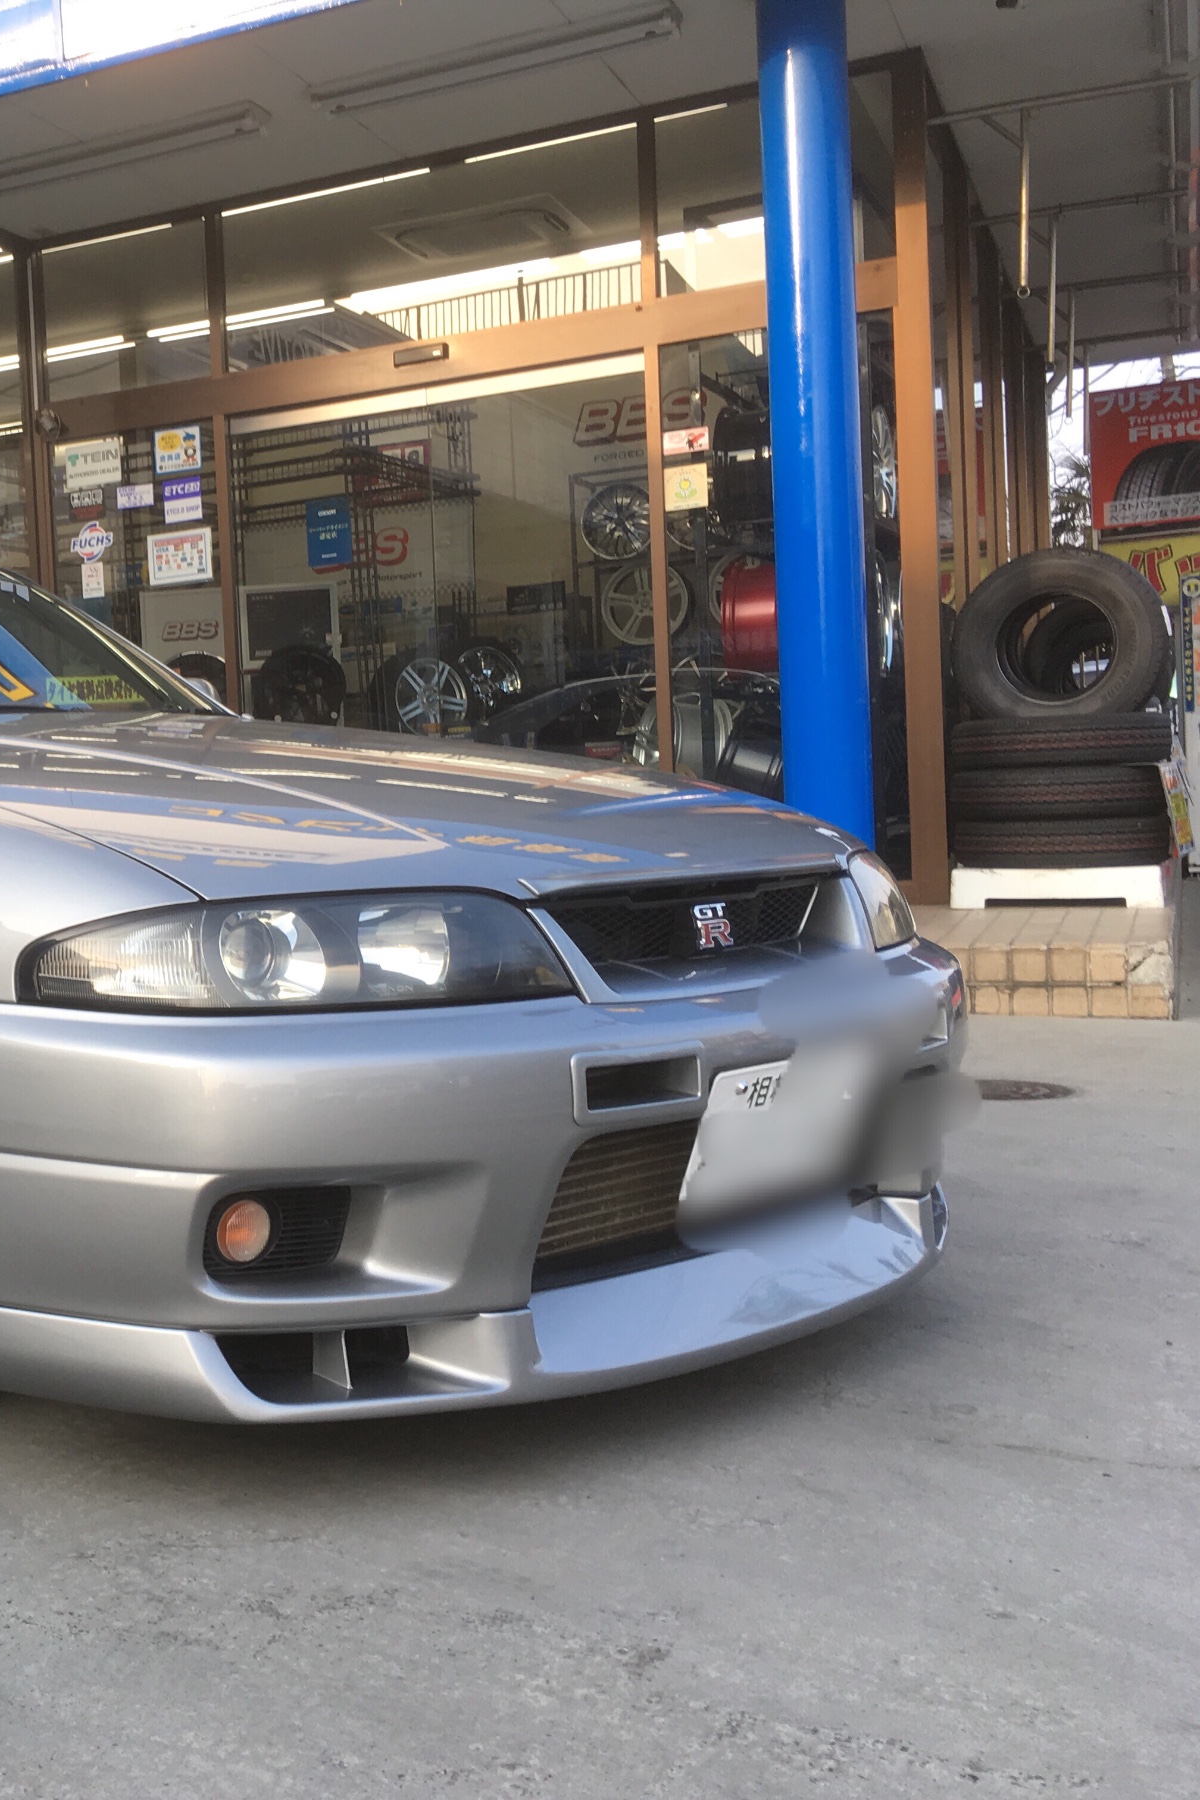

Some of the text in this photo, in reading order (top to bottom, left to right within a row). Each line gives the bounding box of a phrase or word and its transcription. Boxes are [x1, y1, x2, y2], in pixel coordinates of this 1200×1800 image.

[1128, 409, 1199, 427] Firestone
[81, 448, 119, 465] TEIN
[593, 449, 644, 463] FORGED
[72, 533, 112, 551] FUCHS
[161, 620, 219, 642] BBS
[693, 902, 726, 919] GT
[699, 918, 734, 949] R
